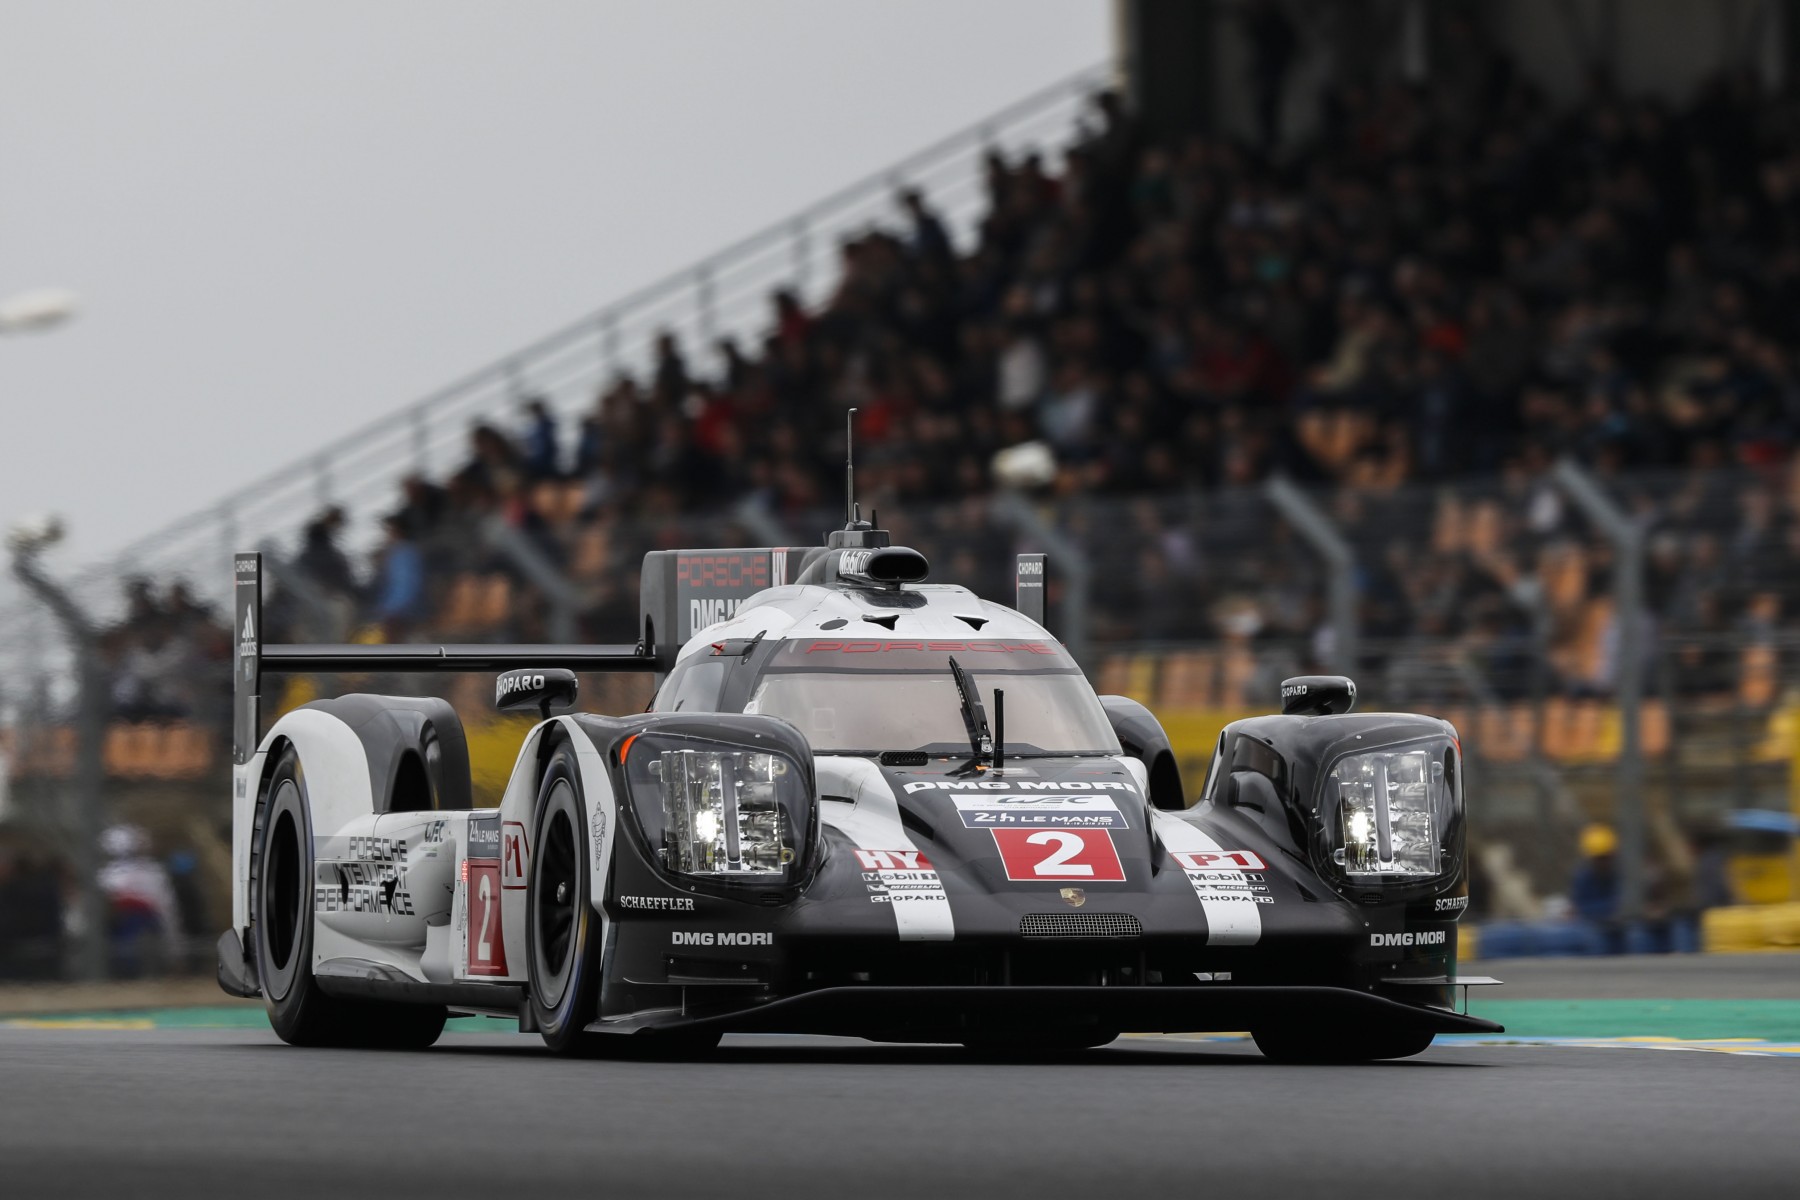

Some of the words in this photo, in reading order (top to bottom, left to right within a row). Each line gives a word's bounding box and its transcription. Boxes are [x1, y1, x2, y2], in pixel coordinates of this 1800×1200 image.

[677, 555, 767, 587] PORSCHE
[1018, 562, 1043, 575] CHOPARD
[805, 641, 1057, 656] PORSCHE
[903, 781, 1010, 795] DMG
[1017, 781, 1138, 795] MORI
[997, 796, 1095, 805] WEC
[1020, 815, 1047, 823] LE
[1051, 815, 1114, 823] MANS
[349, 836, 408, 862] PORSCHE
[504, 833, 523, 878] P1
[1026, 830, 1095, 876] 2
[854, 850, 920, 869] HY
[1187, 853, 1250, 866] P1
[863, 872, 918, 881] Mobil
[1187, 873, 1244, 881] Mobil
[620, 895, 695, 911] SCHAEFFLER
[1200, 895, 1273, 903] CHOPARD
[477, 873, 491, 961] 2
[672, 931, 714, 945] DMG
[717, 932, 773, 946] MORI
[1370, 932, 1414, 947] DMG
[1415, 930, 1446, 946] MORI
